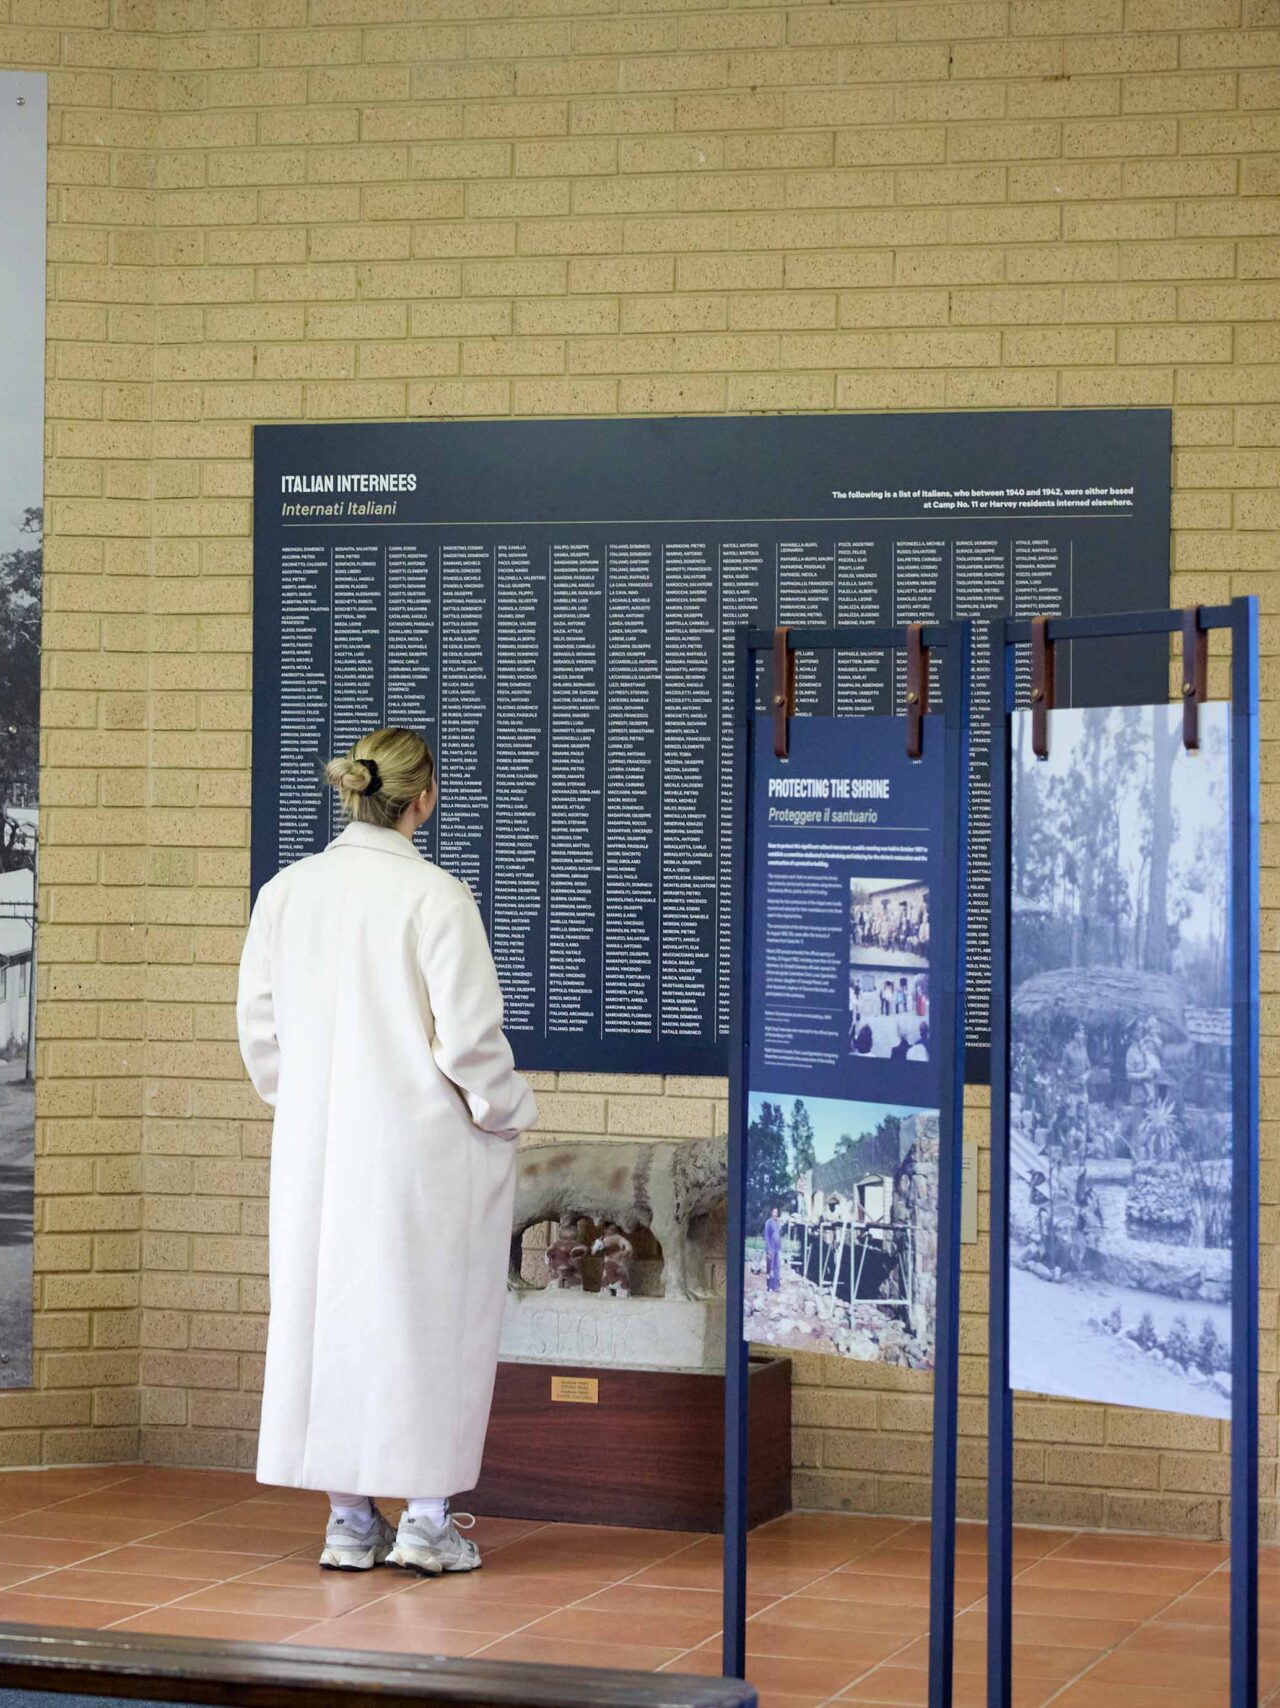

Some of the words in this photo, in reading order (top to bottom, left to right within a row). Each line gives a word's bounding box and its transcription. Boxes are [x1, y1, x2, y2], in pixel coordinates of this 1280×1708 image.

[282, 475, 333, 492] ITALIAN
[338, 474, 416, 492] INTERNEES
[848, 491, 883, 500] following
[282, 502, 344, 515] Internati
[348, 501, 397, 515] Italiani
[933, 501, 955, 510] Camp
[990, 500, 1017, 508] Harvey
[769, 779, 829, 798] PROTECTING
[831, 779, 850, 798] THE
[852, 780, 889, 798] SHRINE
[769, 807, 822, 825] Proteggere
[824, 808, 830, 822] il
[832, 809, 877, 822] santuario
